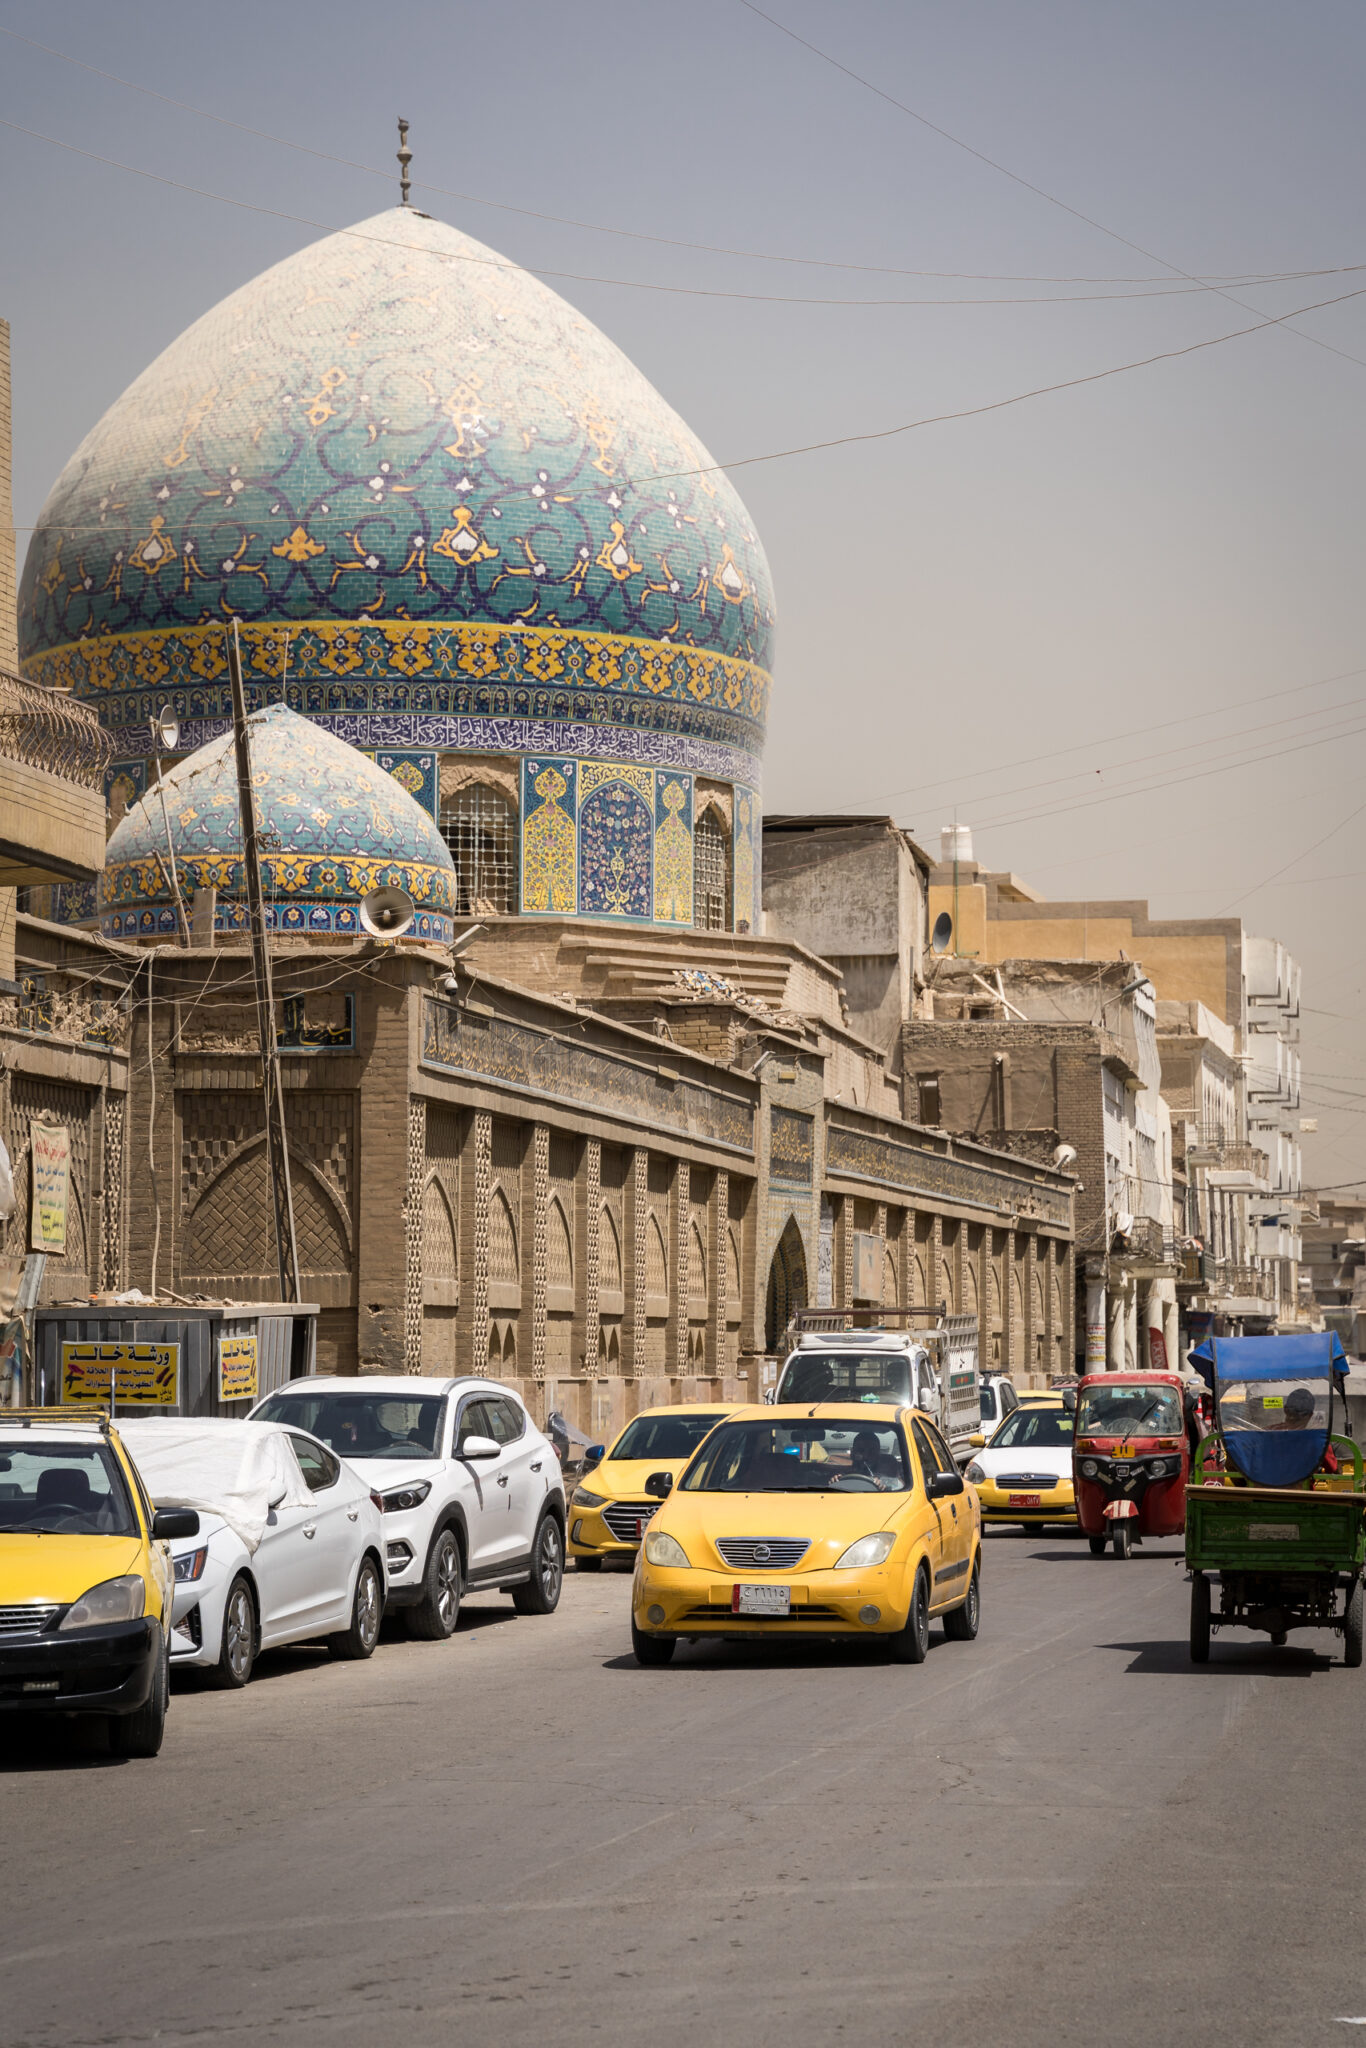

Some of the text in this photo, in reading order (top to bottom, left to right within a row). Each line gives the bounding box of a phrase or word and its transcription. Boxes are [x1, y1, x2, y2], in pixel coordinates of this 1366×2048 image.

[69, 1346, 169, 1365] ورشة خالد
[86, 1366, 109, 1374] الحلاقة
[120, 1379, 154, 1389] الكهربائية
